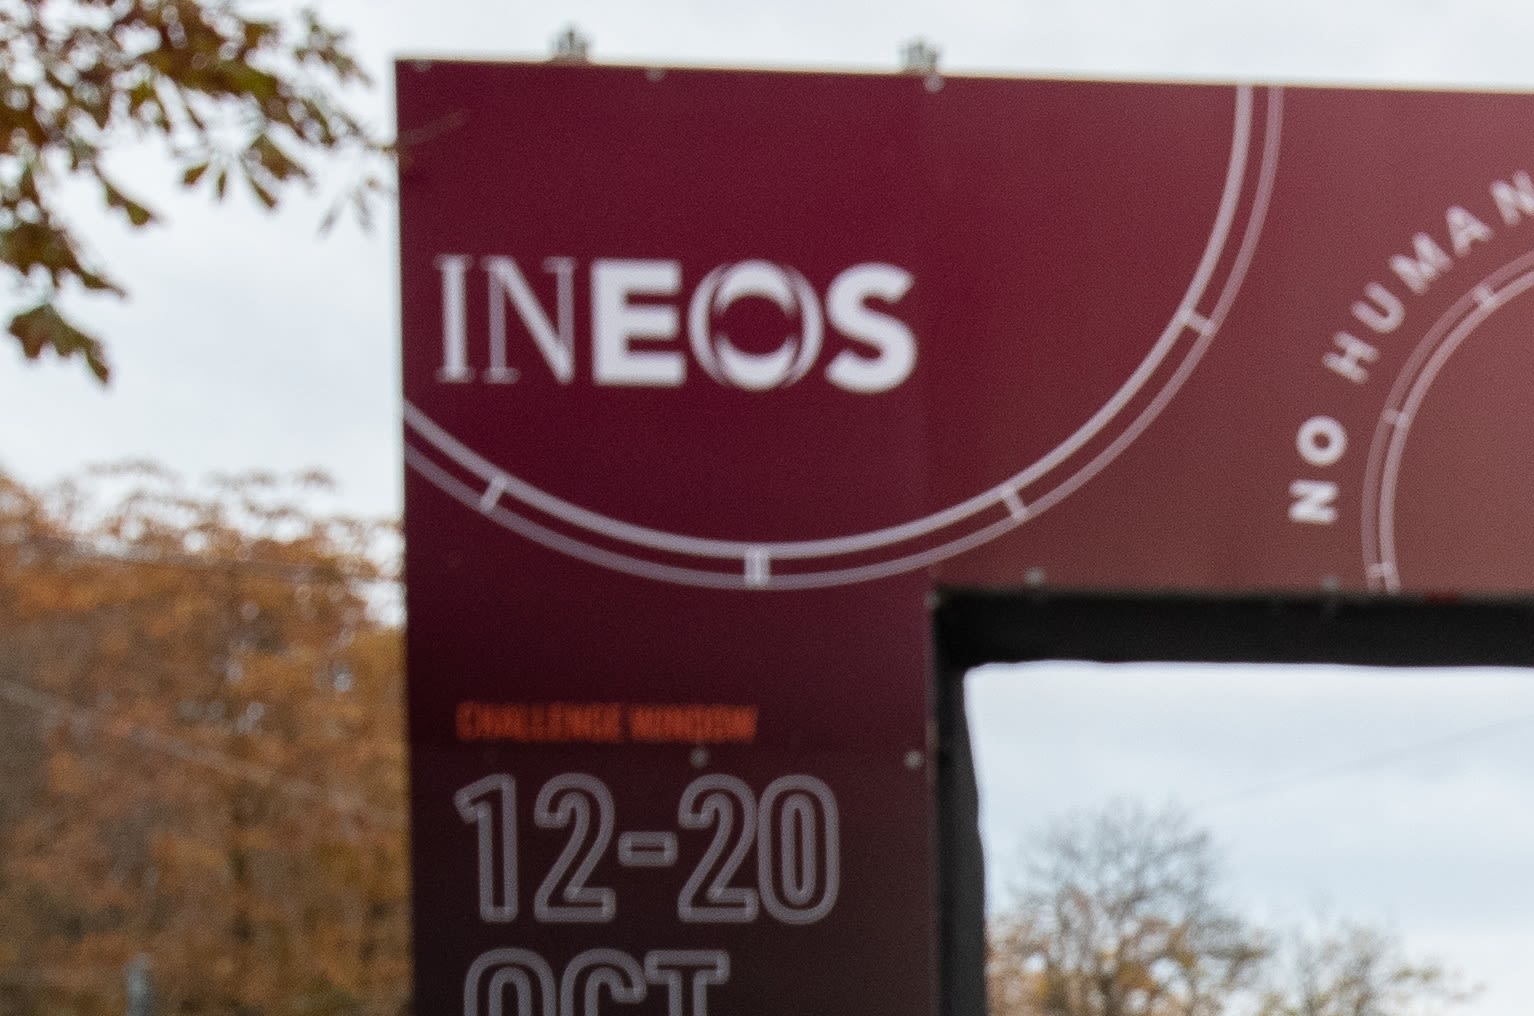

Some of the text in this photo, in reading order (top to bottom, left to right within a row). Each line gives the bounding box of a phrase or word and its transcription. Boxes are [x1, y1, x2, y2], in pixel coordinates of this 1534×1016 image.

[435, 252, 919, 393] INEOS
[1288, 414, 1348, 526] NO
[453, 772, 842, 925] 12-20
